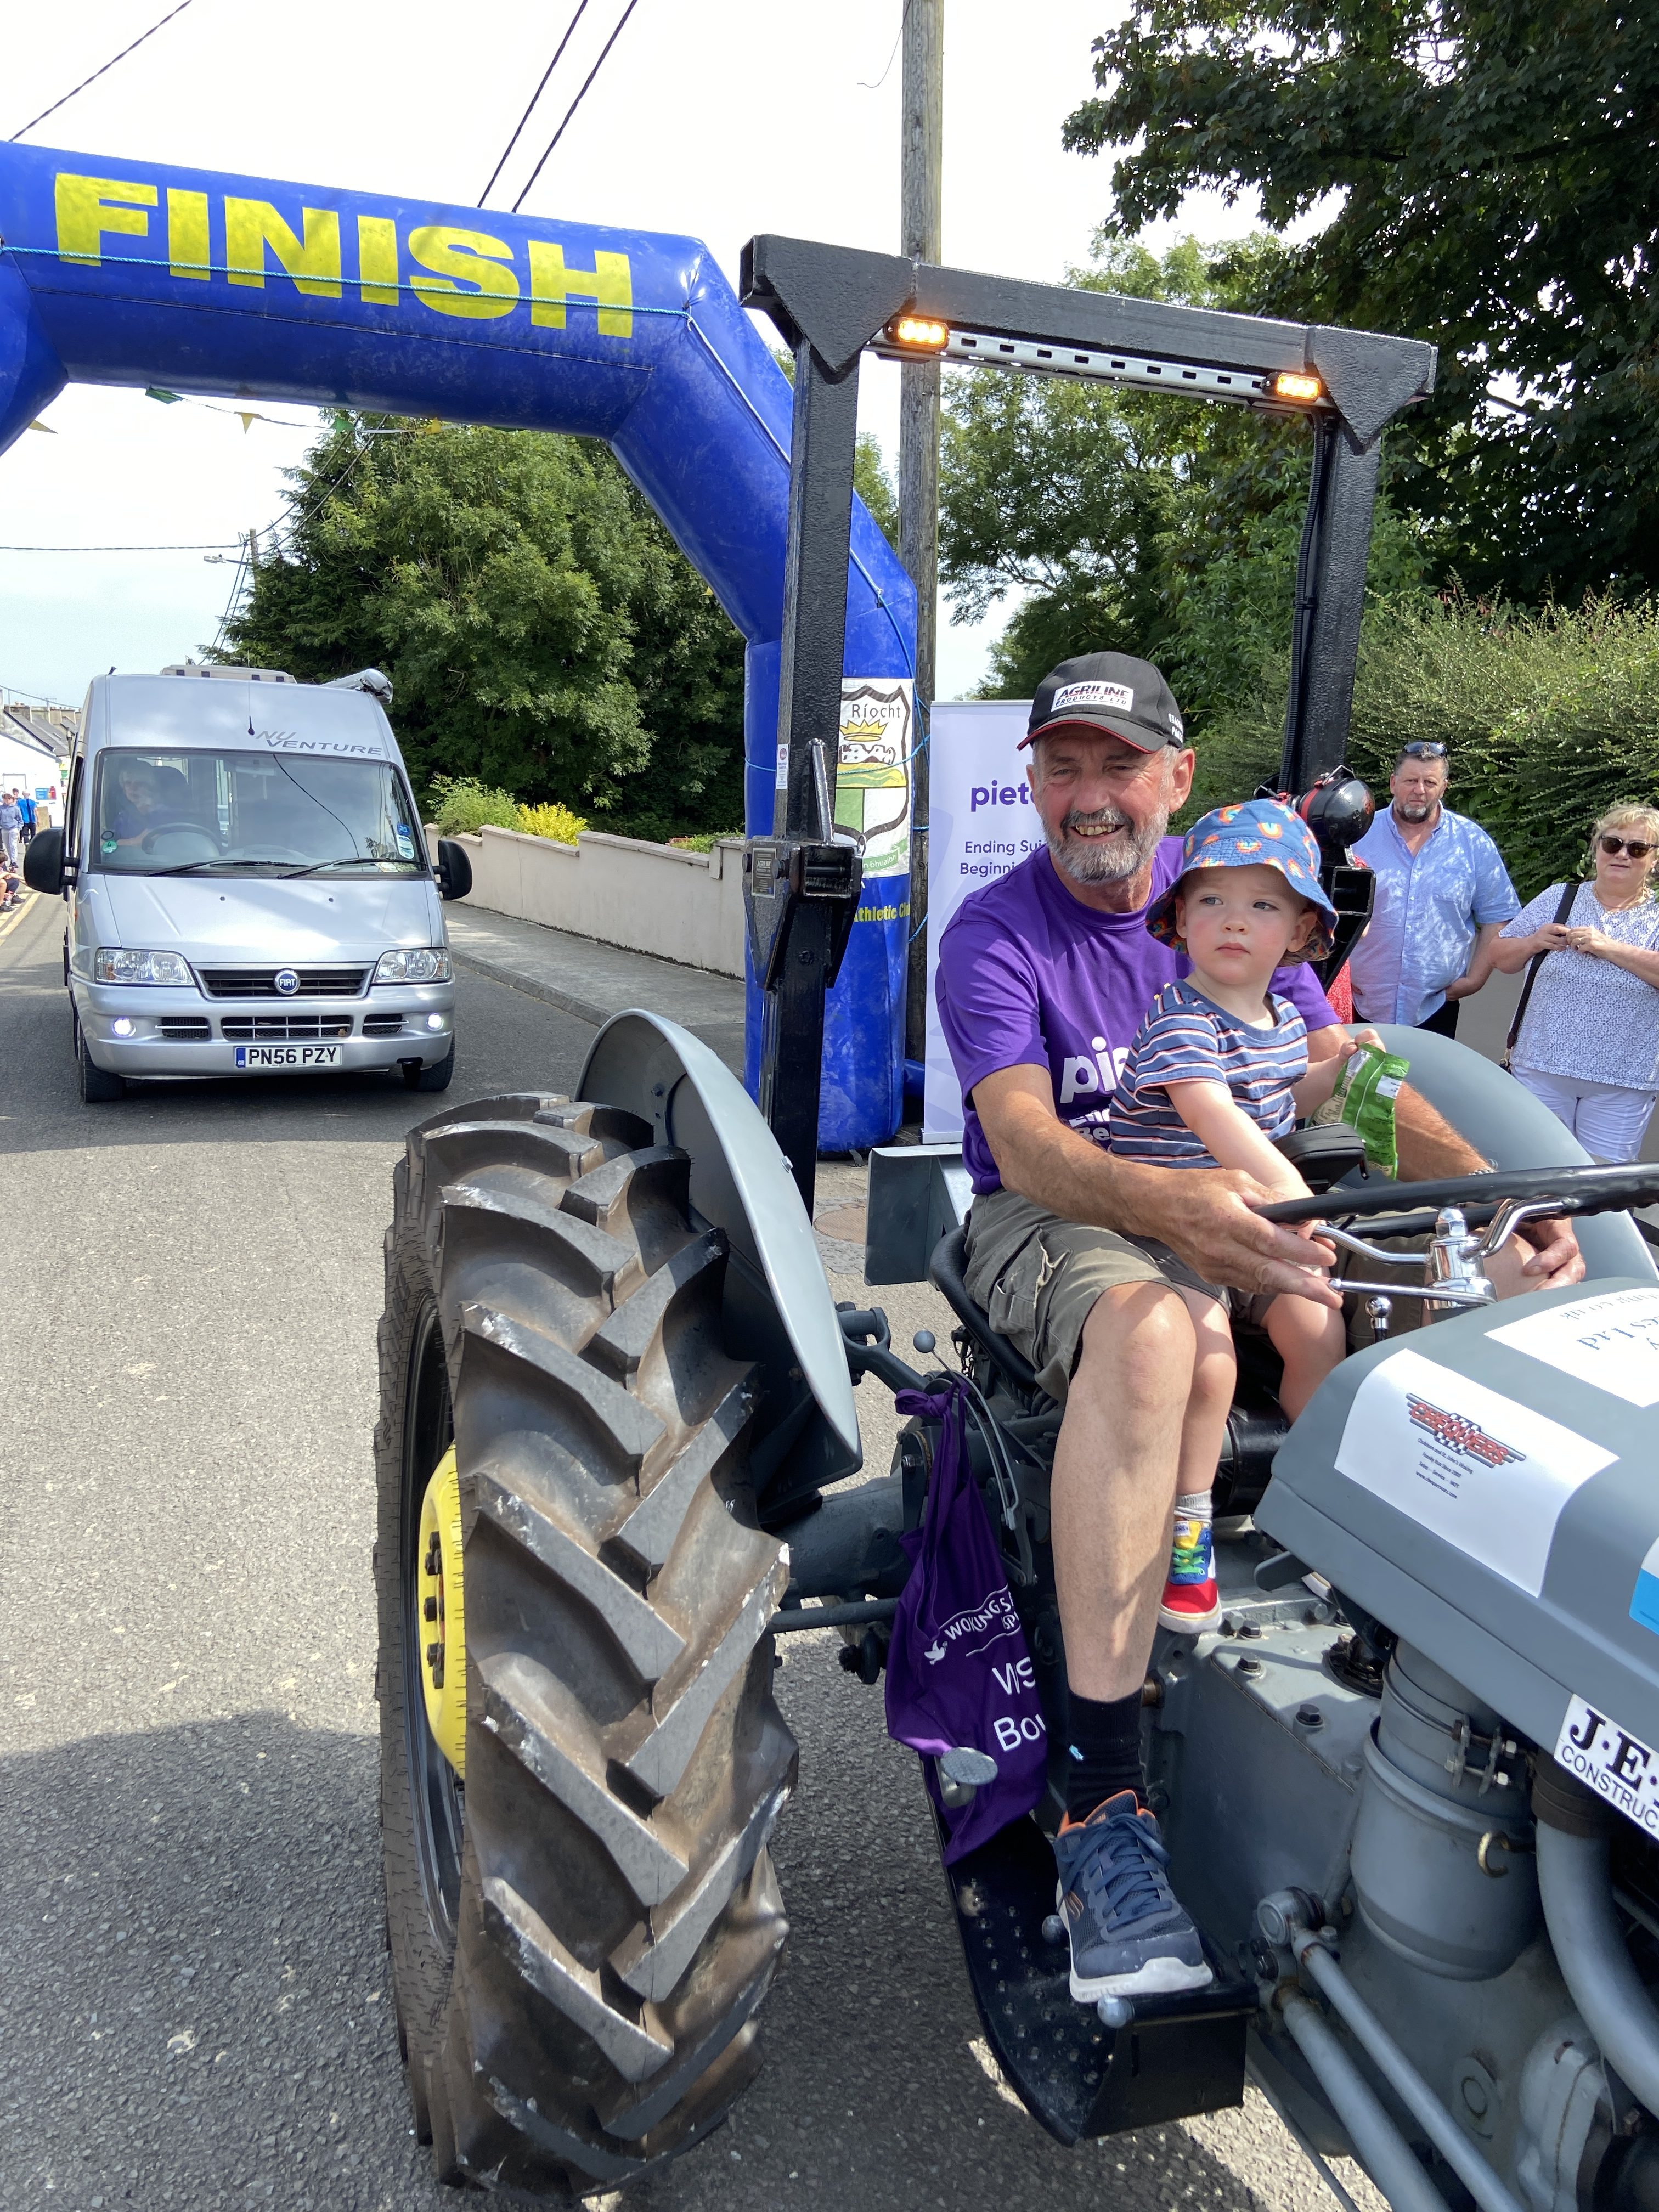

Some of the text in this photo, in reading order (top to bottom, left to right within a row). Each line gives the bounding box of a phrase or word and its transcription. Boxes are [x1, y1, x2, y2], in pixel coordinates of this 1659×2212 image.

[54, 172, 634, 339] FINISH
[1055, 695, 1104, 706] PRODUCTS
[1057, 685, 1129, 701] AGRILINE
[851, 703, 900, 718] Ríocht
[256, 731, 297, 741] NU
[267, 740, 383, 755] VENTURE
[970, 780, 1034, 812] piet
[965, 840, 1015, 856] Ending
[960, 861, 1017, 878] Beginni
[279, 978, 296, 986] FIAT
[249, 1047, 337, 1064] PN56 PZY
[1411, 1403, 1509, 1464] CHEQUERS
